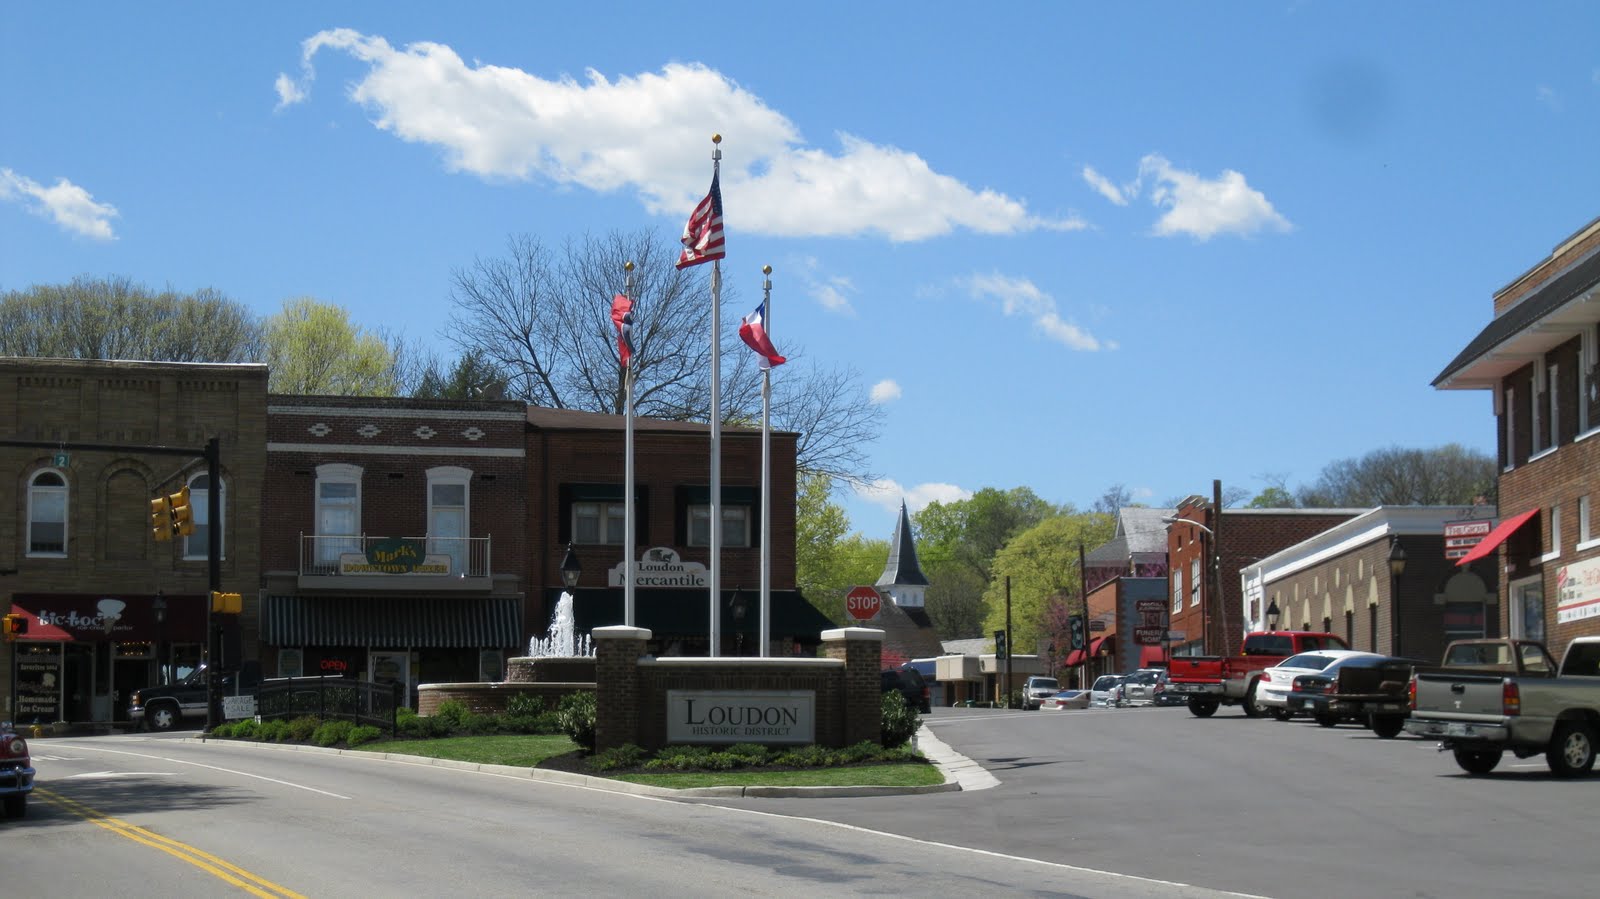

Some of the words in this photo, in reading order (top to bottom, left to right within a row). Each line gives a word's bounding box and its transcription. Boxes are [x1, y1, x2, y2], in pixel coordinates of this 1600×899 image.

[58, 456, 66, 467] 2
[638, 562, 684, 572] Loudon
[849, 596, 879, 608] STOP
[37, 608, 103, 627] tic-toc
[320, 660, 347, 671] OPEN
[18, 695, 57, 703] Homemade
[684, 700, 799, 726] LOUDON
[692, 726, 741, 736] HISTORIC
[744, 726, 791, 736] DISTRICT
